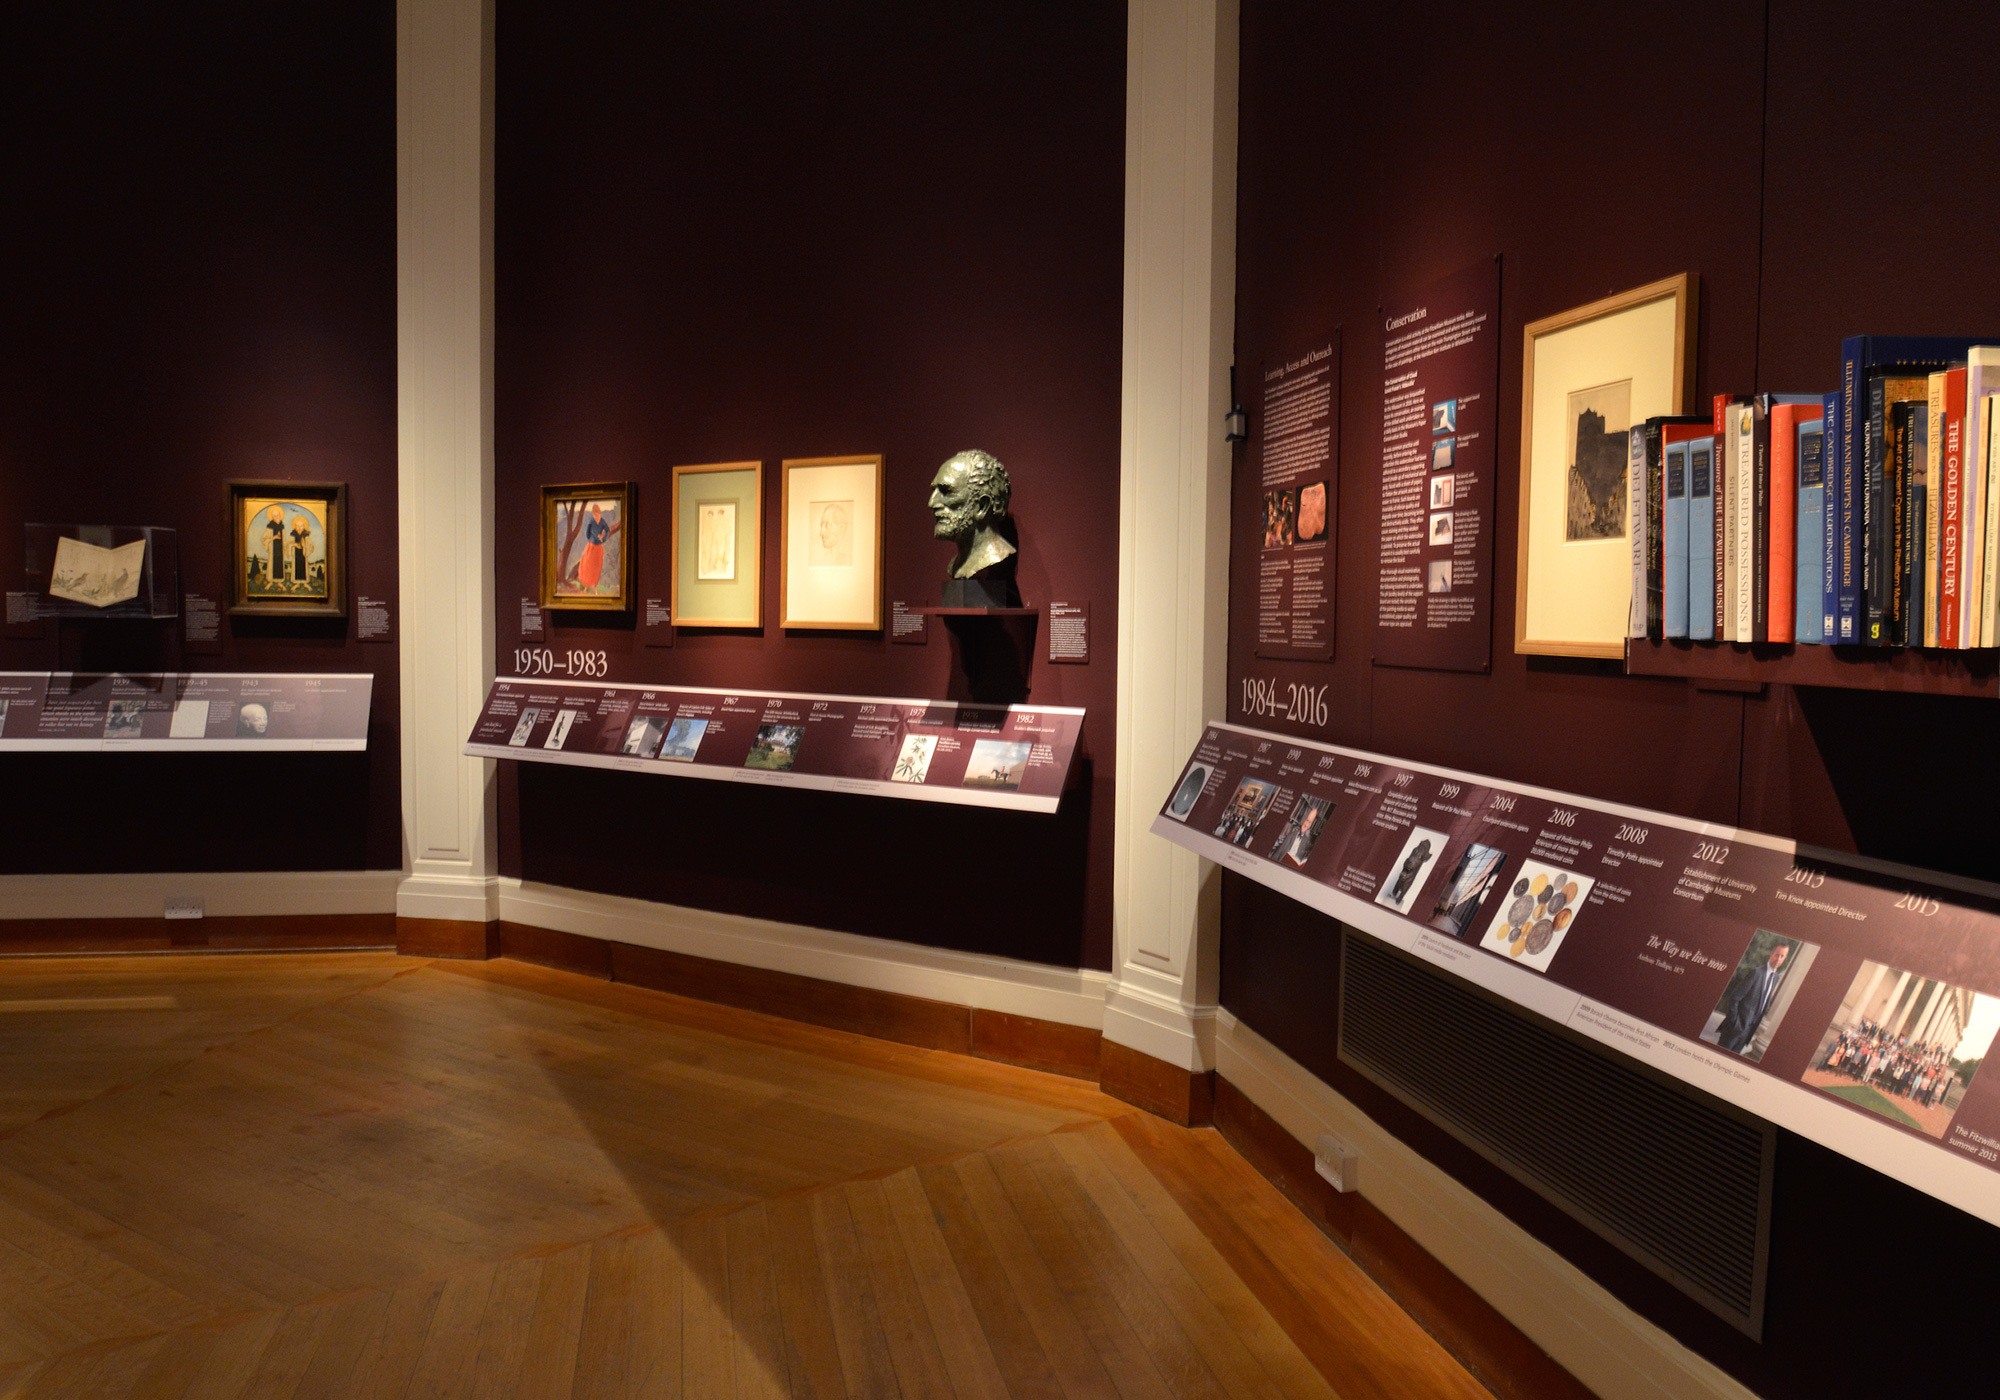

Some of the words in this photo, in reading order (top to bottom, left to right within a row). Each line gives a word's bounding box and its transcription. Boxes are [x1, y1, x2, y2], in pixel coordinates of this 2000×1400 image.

[1385, 307, 1427, 331] Conservation
[1285, 360, 1300, 373] Access
[1300, 354, 1309, 368] and
[1309, 344, 1333, 363] Outreach
[1845, 360, 1853, 432] ILLUMINATED
[1827, 401, 1835, 428] THE
[1871, 388, 1882, 438] DEATH
[1930, 388, 1940, 453] TREASURES
[1896, 427, 1904, 442] The
[1949, 420, 1959, 453] THE
[1896, 444, 1904, 454] Art
[1896, 455, 1903, 464] of
[1715, 444, 1723, 483] Treasures
[1826, 429, 1835, 501] CAMBRIDGE
[1844, 434, 1852, 509] MANUSCRIPTS
[1907, 459, 1913, 471] OF
[1714, 484, 1723, 494] of
[1741, 440, 1749, 526] TREASURED
[1871, 462, 1882, 494] NILE
[1895, 465, 1903, 496] Ancient
[1947, 456, 1958, 520] GOLDEN
[1632, 463, 1641, 572] DELFTWARE
[1844, 511, 1852, 523] IN
[1894, 496, 1902, 524] Cyprus
[1905, 489, 1913, 539] FITZWILLIAM
[1895, 525, 1901, 533] in
[1928, 488, 1938, 561] FITZWILLIAM
[1825, 502, 1834, 593] ILLUMINATIONS
[1843, 525, 1852, 588] CAMBRIDGE
[1862, 532, 1870, 566] Sally-Ann
[1945, 524, 1956, 597] CENTURY
[1740, 531, 1748, 622] POSSESSIONS
[1893, 587, 1901, 622] Museum
[513, 648, 608, 678] 1950–1983
[723, 697, 739, 705] 1967
[766, 699, 782, 708] 1970
[812, 702, 828, 711] 1972
[860, 705, 876, 713] 1973
[909, 707, 926, 717] 1975
[1241, 677, 1329, 727] 1984–2016
[1016, 714, 1035, 724] 1982
[1286, 749, 1302, 761] 1990
[1318, 756, 1335, 769] 1995
[1353, 764, 1373, 778] 1996
[1393, 773, 1414, 787] 1997
[1438, 784, 1460, 799] 1999
[1489, 796, 1518, 813] 2004
[1547, 808, 1579, 828] 2006
[1561, 834, 1581, 847] Professor
[1614, 823, 1649, 845] 2008
[1601, 856, 1621, 868] Director
[1606, 846, 1626, 860] Timothy
[1625, 851, 1639, 862] Potts
[1638, 855, 1665, 869] appointed
[1692, 841, 1730, 865] 2012
[1683, 866, 1722, 886] Establishment
[1727, 877, 1758, 894] University
[1684, 878, 1714, 895] Cambridge
[1713, 885, 1742, 901] Museums
[1784, 865, 1825, 890] 2013
[1672, 886, 1705, 902] Consortium
[1775, 889, 1787, 900] Tim
[1787, 893, 1804, 906] Knox
[1804, 897, 1839, 915] appointed
[1838, 905, 1868, 922] Director
[1894, 890, 1943, 917] 2015
[1646, 934, 1662, 949] The
[1662, 939, 1680, 959] Way
[1679, 949, 1692, 960] we
[1691, 949, 1708, 965] live
[1707, 959, 1728, 972] now
[1663, 1040, 1676, 1050] 2012
[1675, 1045, 1692, 1057] London
[1692, 1052, 1705, 1063] hosts
[1704, 1057, 1714, 1066] the
[1713, 1061, 1733, 1077] Olympic
[1733, 1070, 1751, 1084] Games
[1949, 1137, 1979, 1155] summer
[1978, 1148, 1998, 1162] 2015
[1955, 1125, 1969, 1138] The
[1969, 1130, 2000, 1151] Fitzwillia
